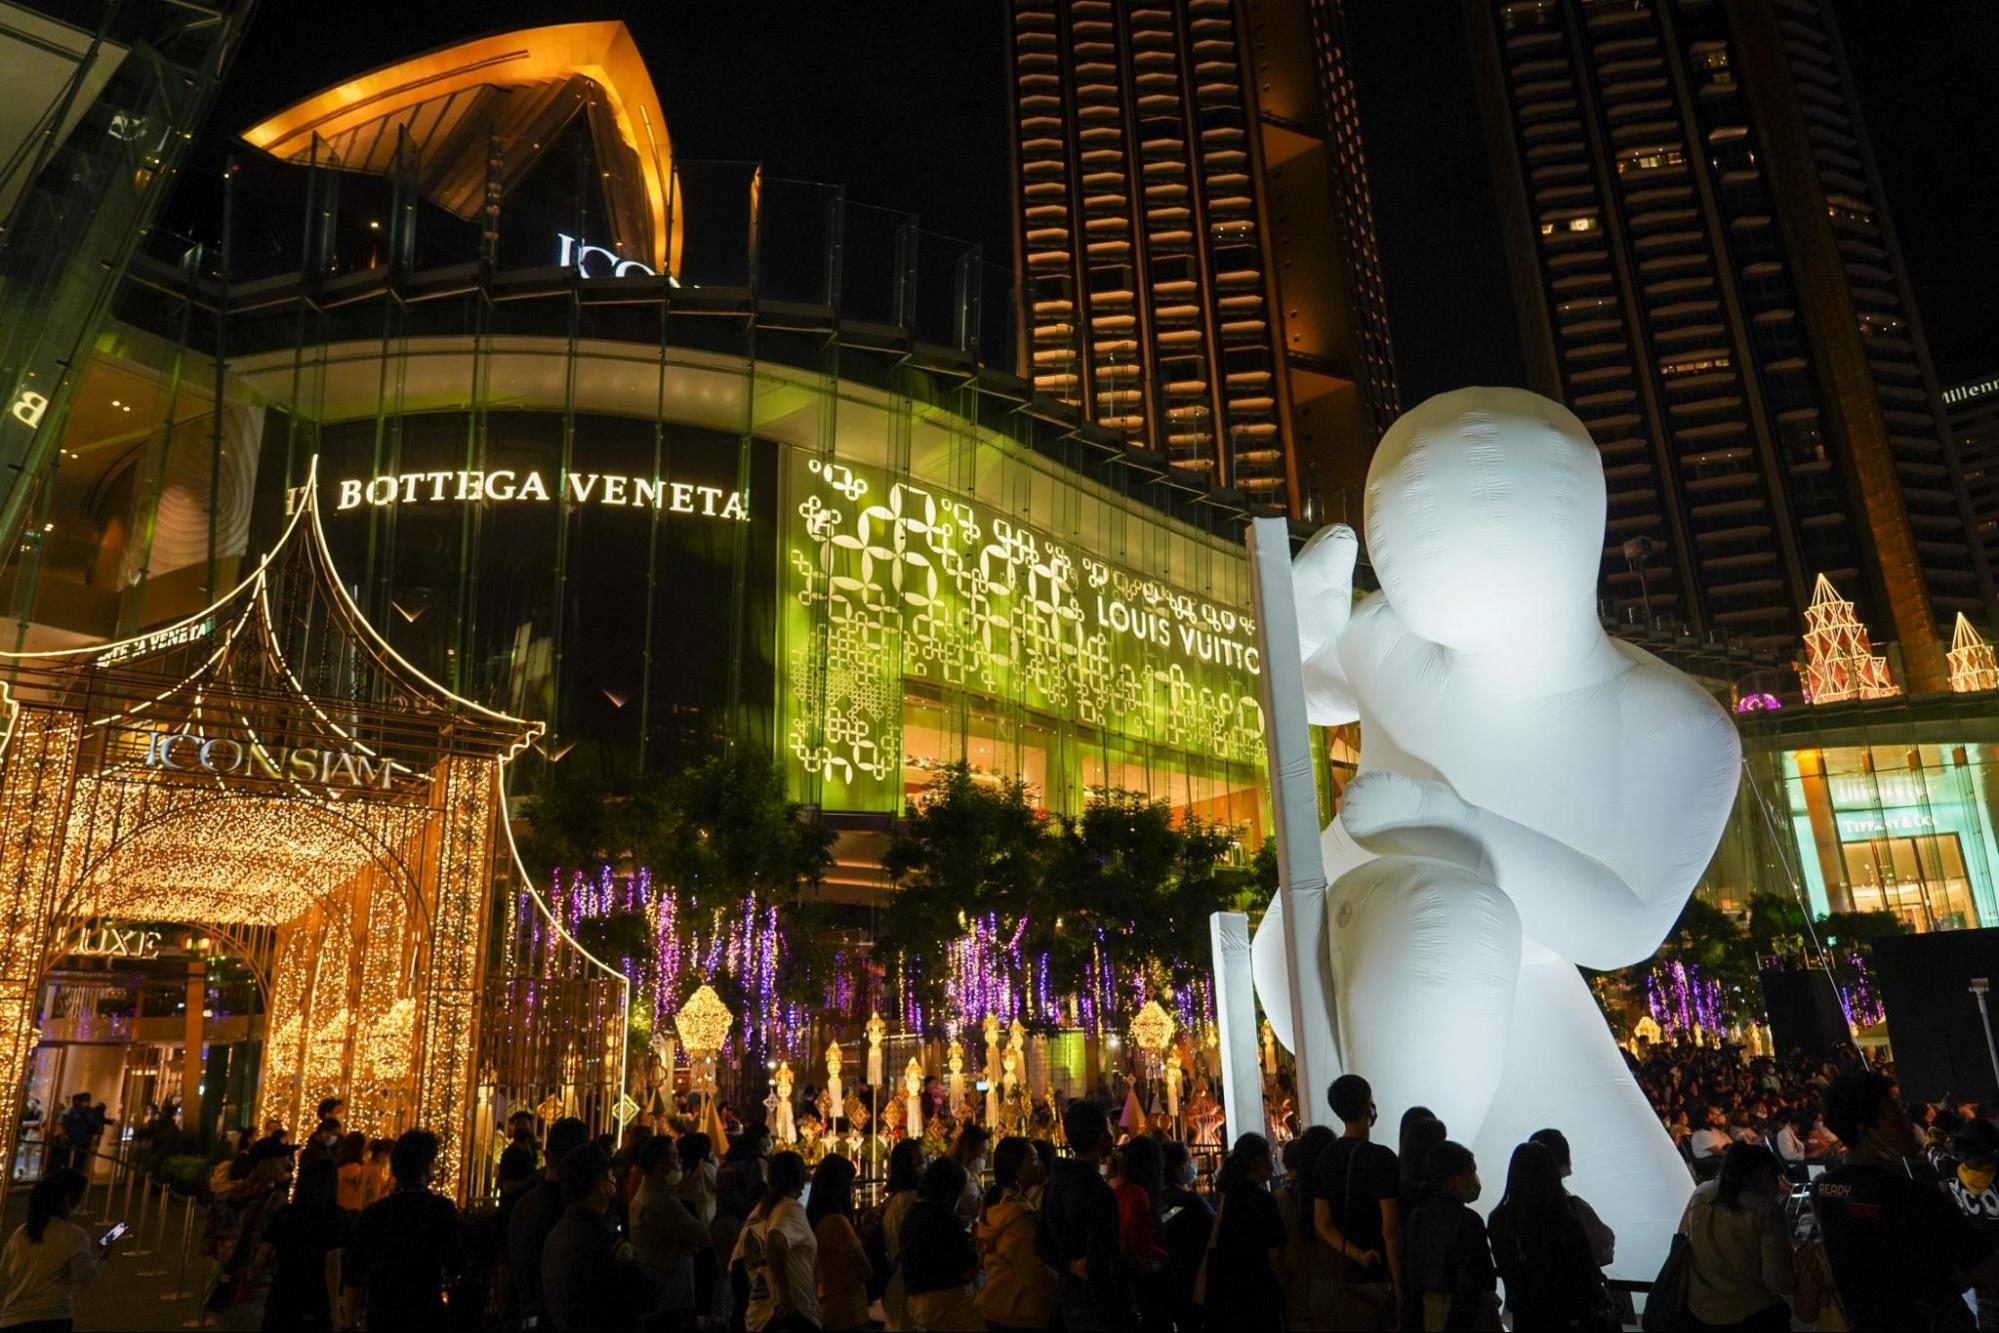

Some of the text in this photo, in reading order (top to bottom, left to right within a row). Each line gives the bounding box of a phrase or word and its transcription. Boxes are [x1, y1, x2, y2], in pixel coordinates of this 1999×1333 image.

[337, 471, 550, 510] BOTTEGA
[569, 473, 751, 522] VENETA
[1097, 595, 1171, 647] LOUIS
[145, 731, 393, 789] ICONSIAM
